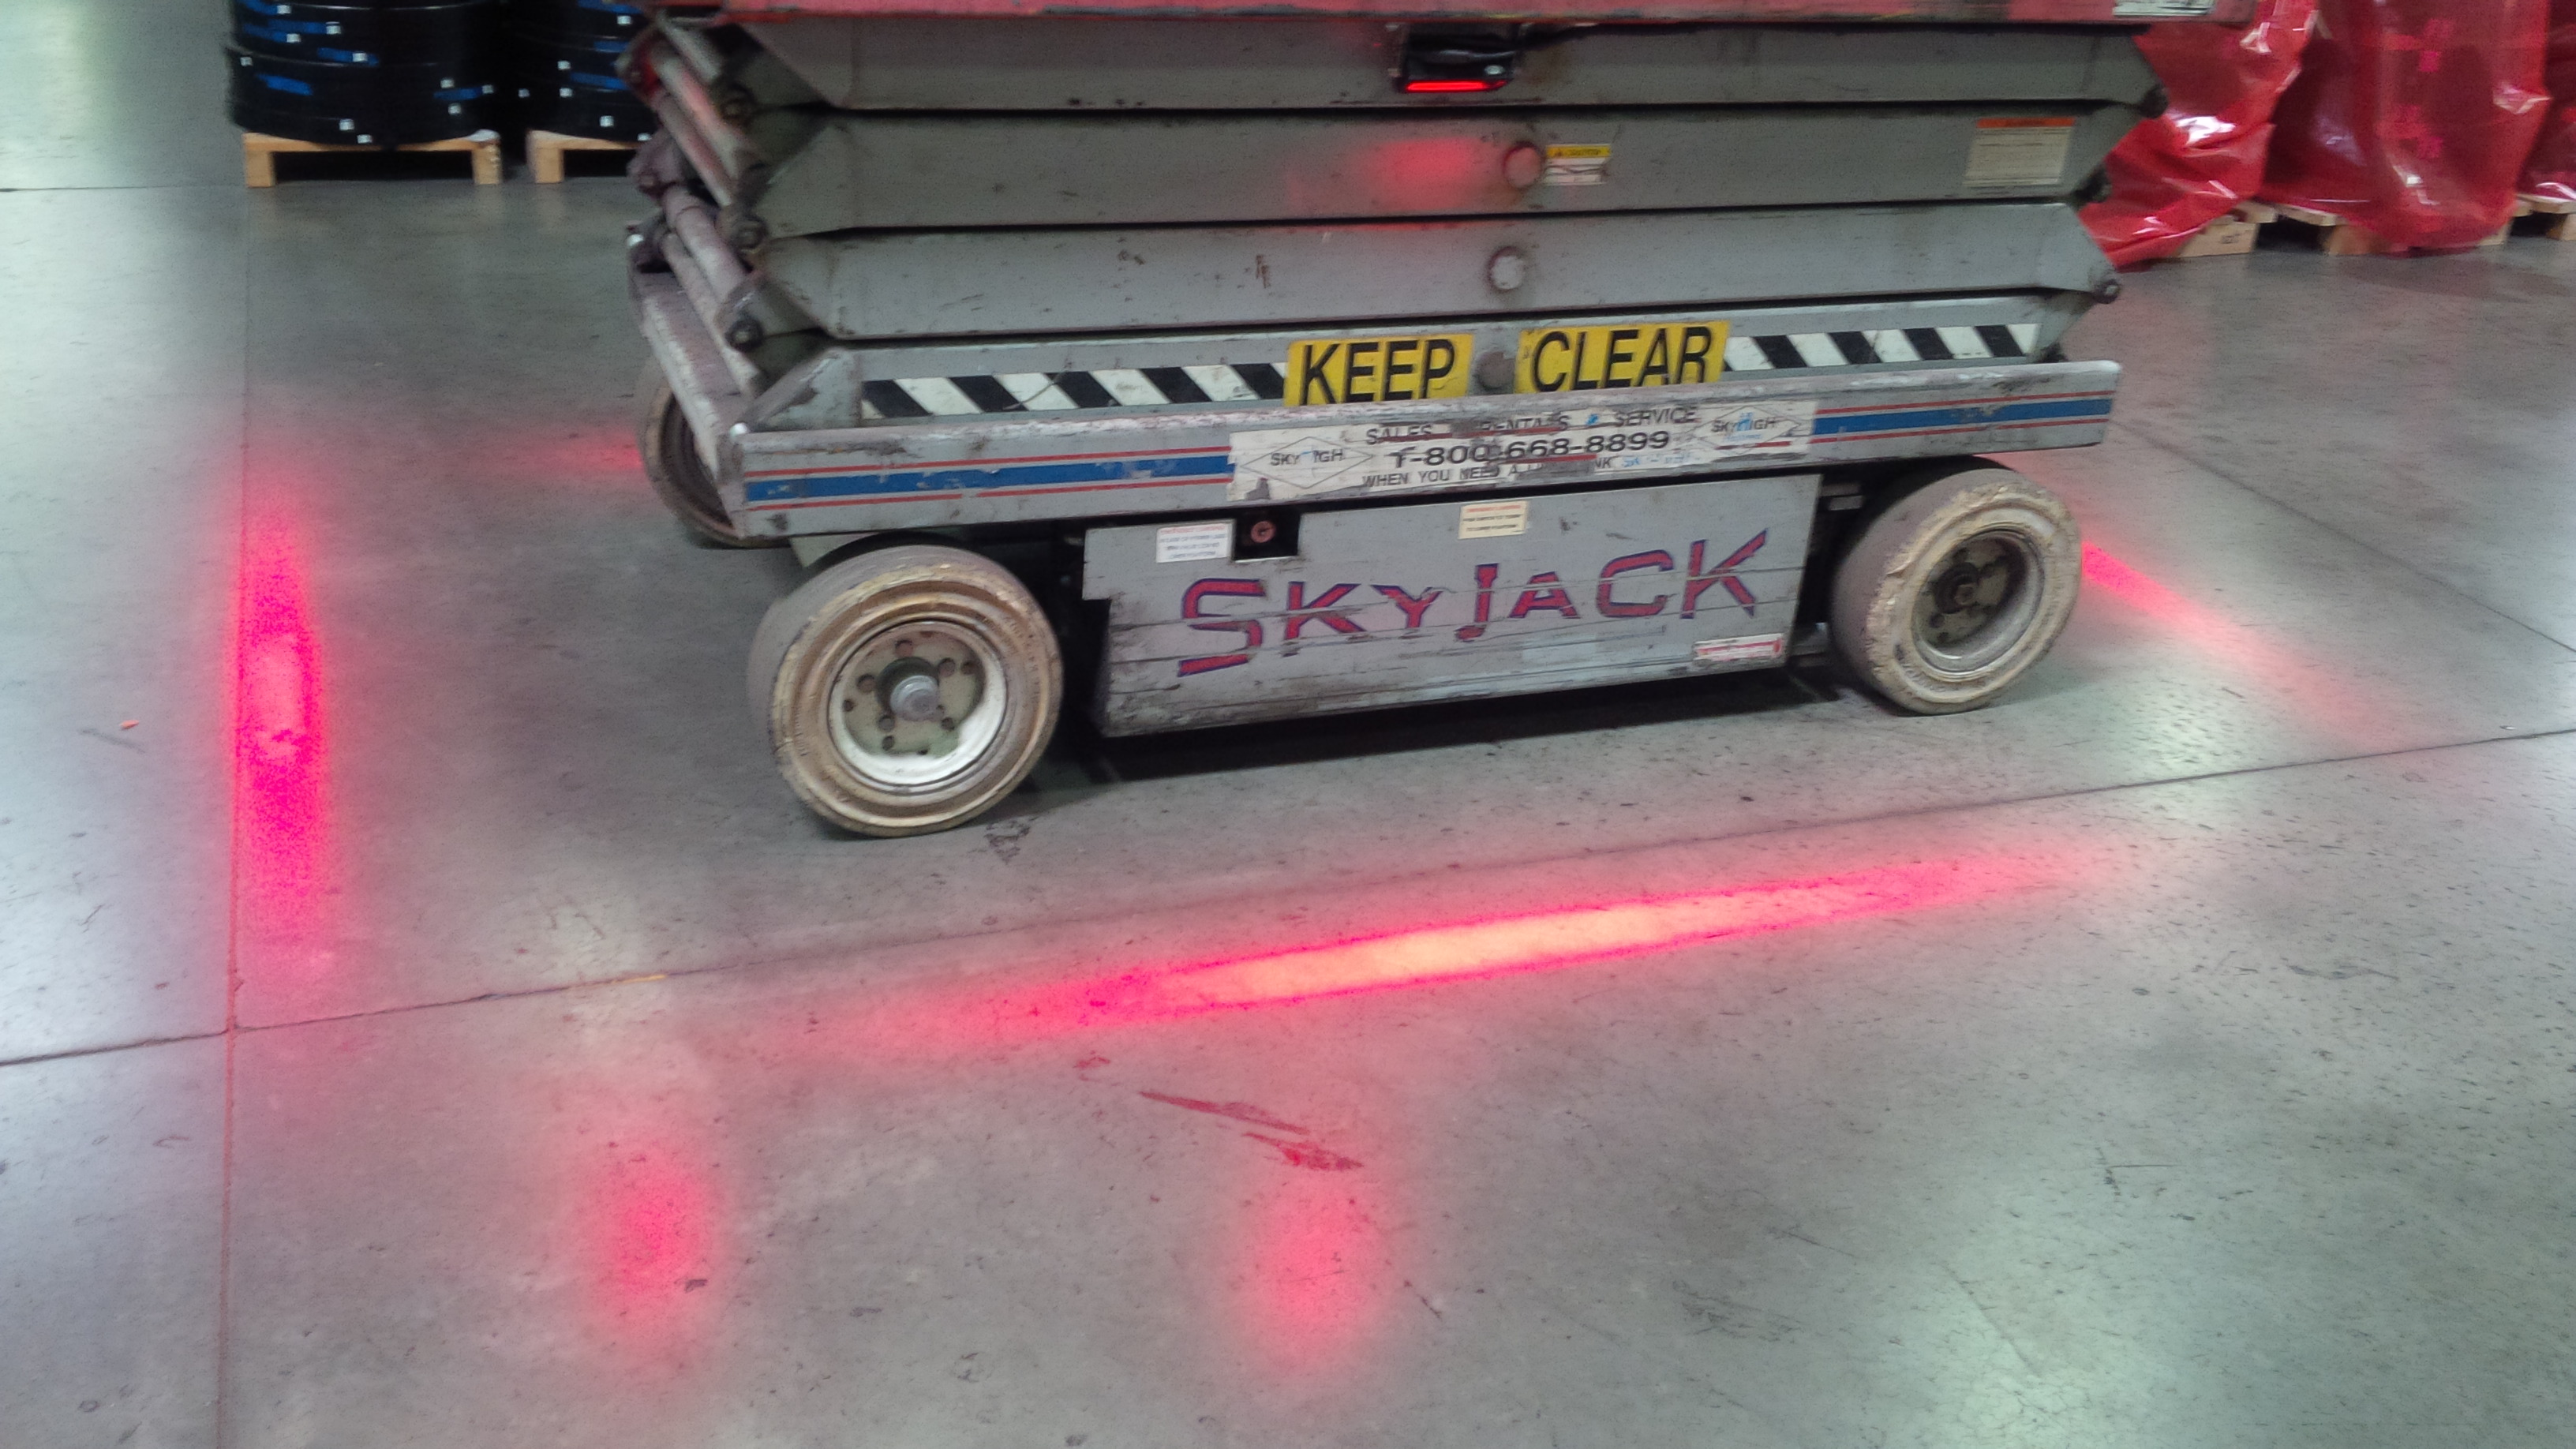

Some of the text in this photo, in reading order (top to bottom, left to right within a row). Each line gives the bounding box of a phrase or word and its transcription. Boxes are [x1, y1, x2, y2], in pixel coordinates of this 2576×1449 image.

[1299, 325, 1713, 405] KEEP CLEAR
[1614, 405, 1698, 427] SERVICE
[1270, 440, 1345, 466] SKYIGH
[1362, 472, 1409, 488] WHEN
[1418, 469, 1451, 483] YOU
[1176, 528, 1768, 678] SKYJACK
